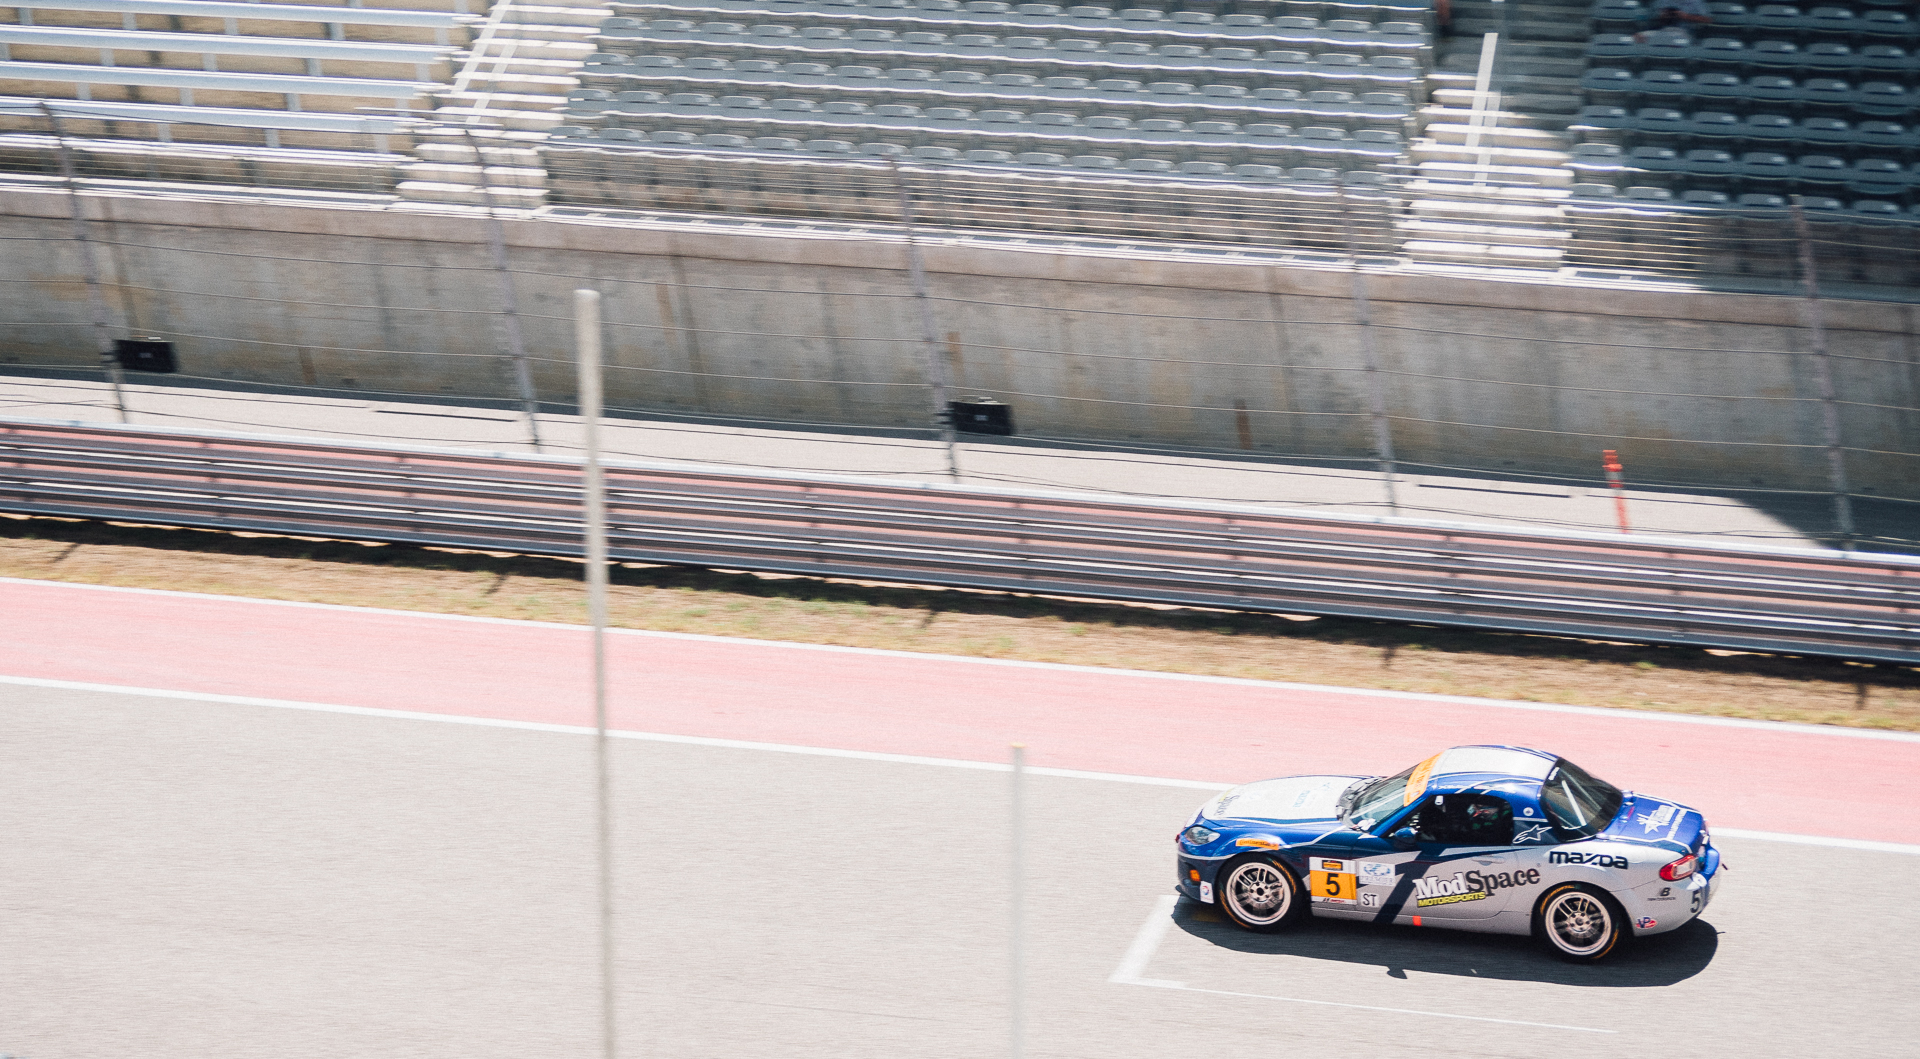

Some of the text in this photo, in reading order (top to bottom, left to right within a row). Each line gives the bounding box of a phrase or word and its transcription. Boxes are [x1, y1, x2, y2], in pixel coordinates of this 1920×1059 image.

[1326, 873, 1341, 896] 5
[1412, 868, 1541, 900] ModSpace
[1362, 893, 1378, 907] ST
[1418, 891, 1486, 908] MOTORSPORTS
[1690, 890, 1701, 914] 5
